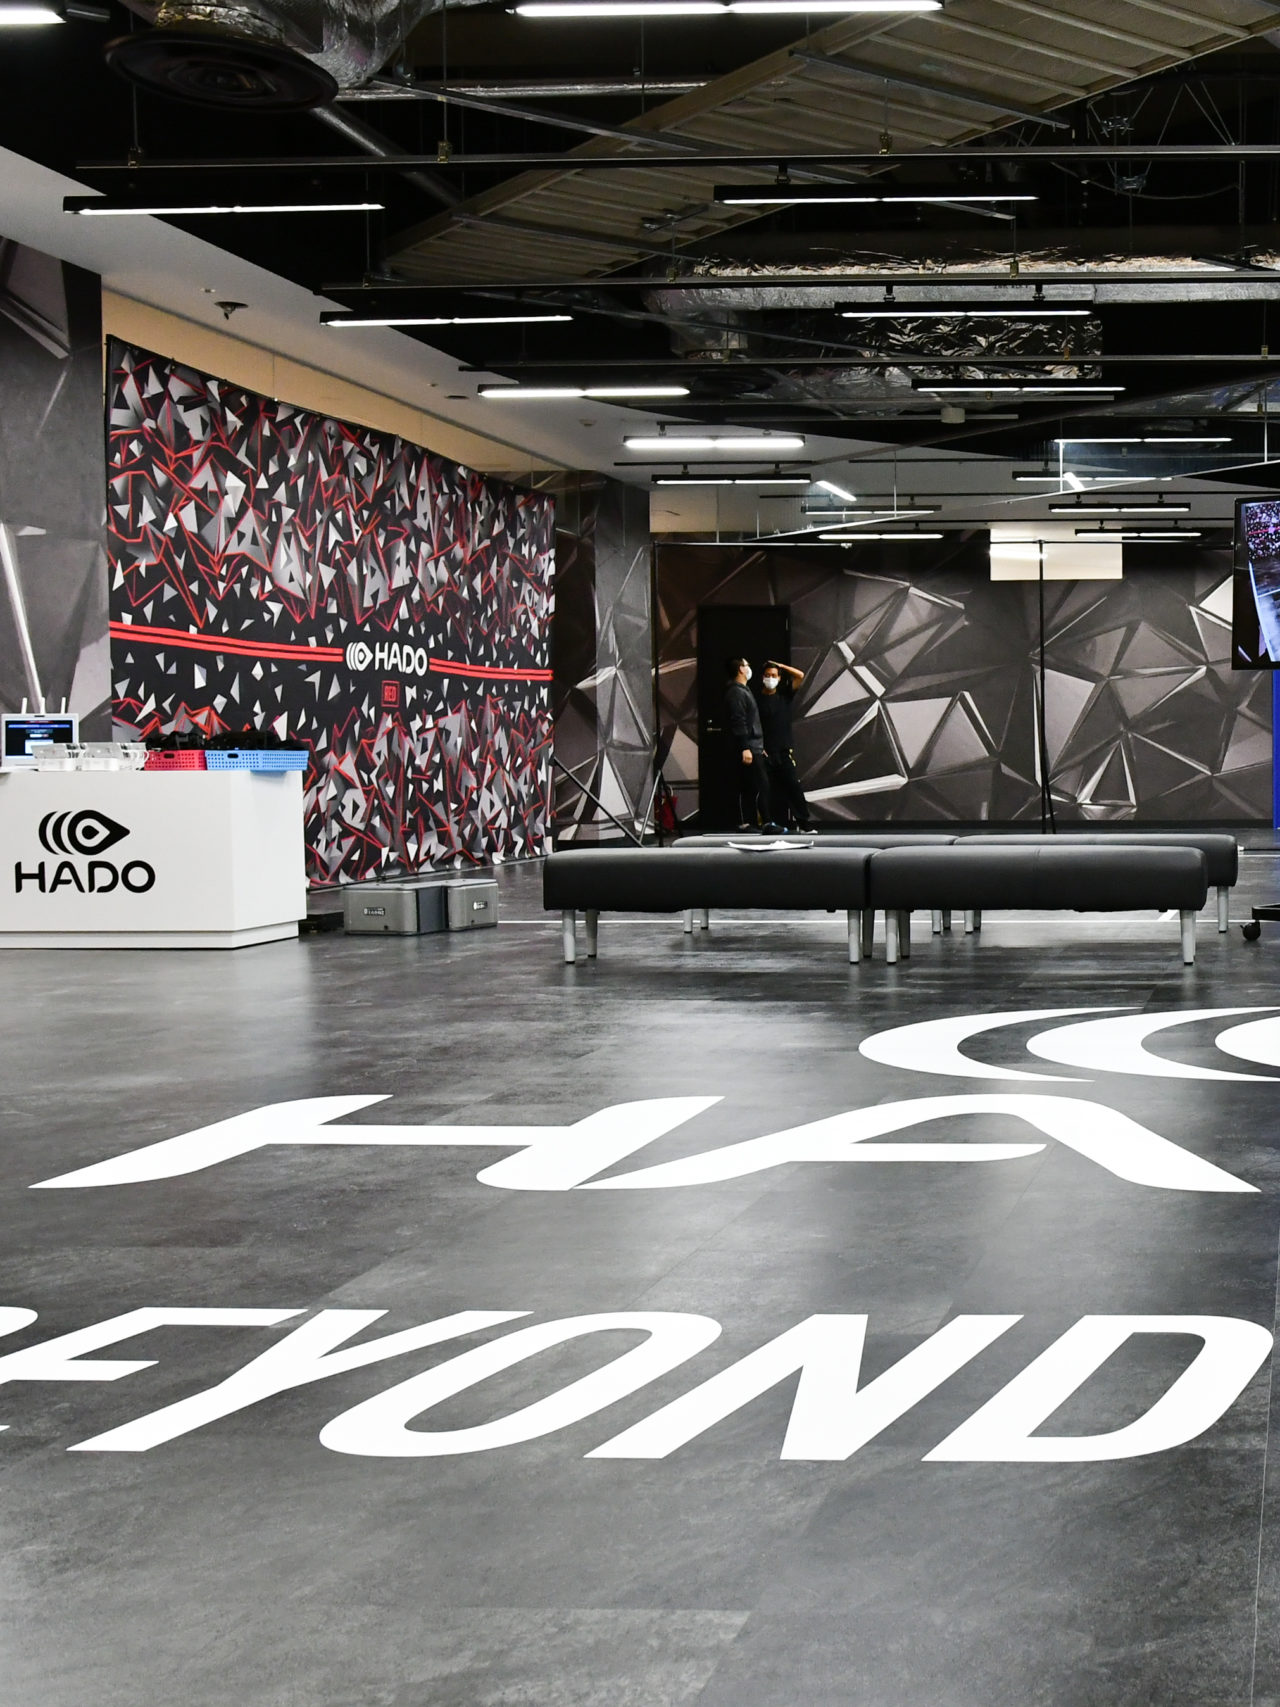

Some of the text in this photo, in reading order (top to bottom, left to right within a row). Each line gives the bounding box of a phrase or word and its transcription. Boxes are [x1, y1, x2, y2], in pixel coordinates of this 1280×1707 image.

[375, 641, 428, 677] HADO
[15, 860, 156, 894] HADO
[0, 1306, 1274, 1462] EYOND
